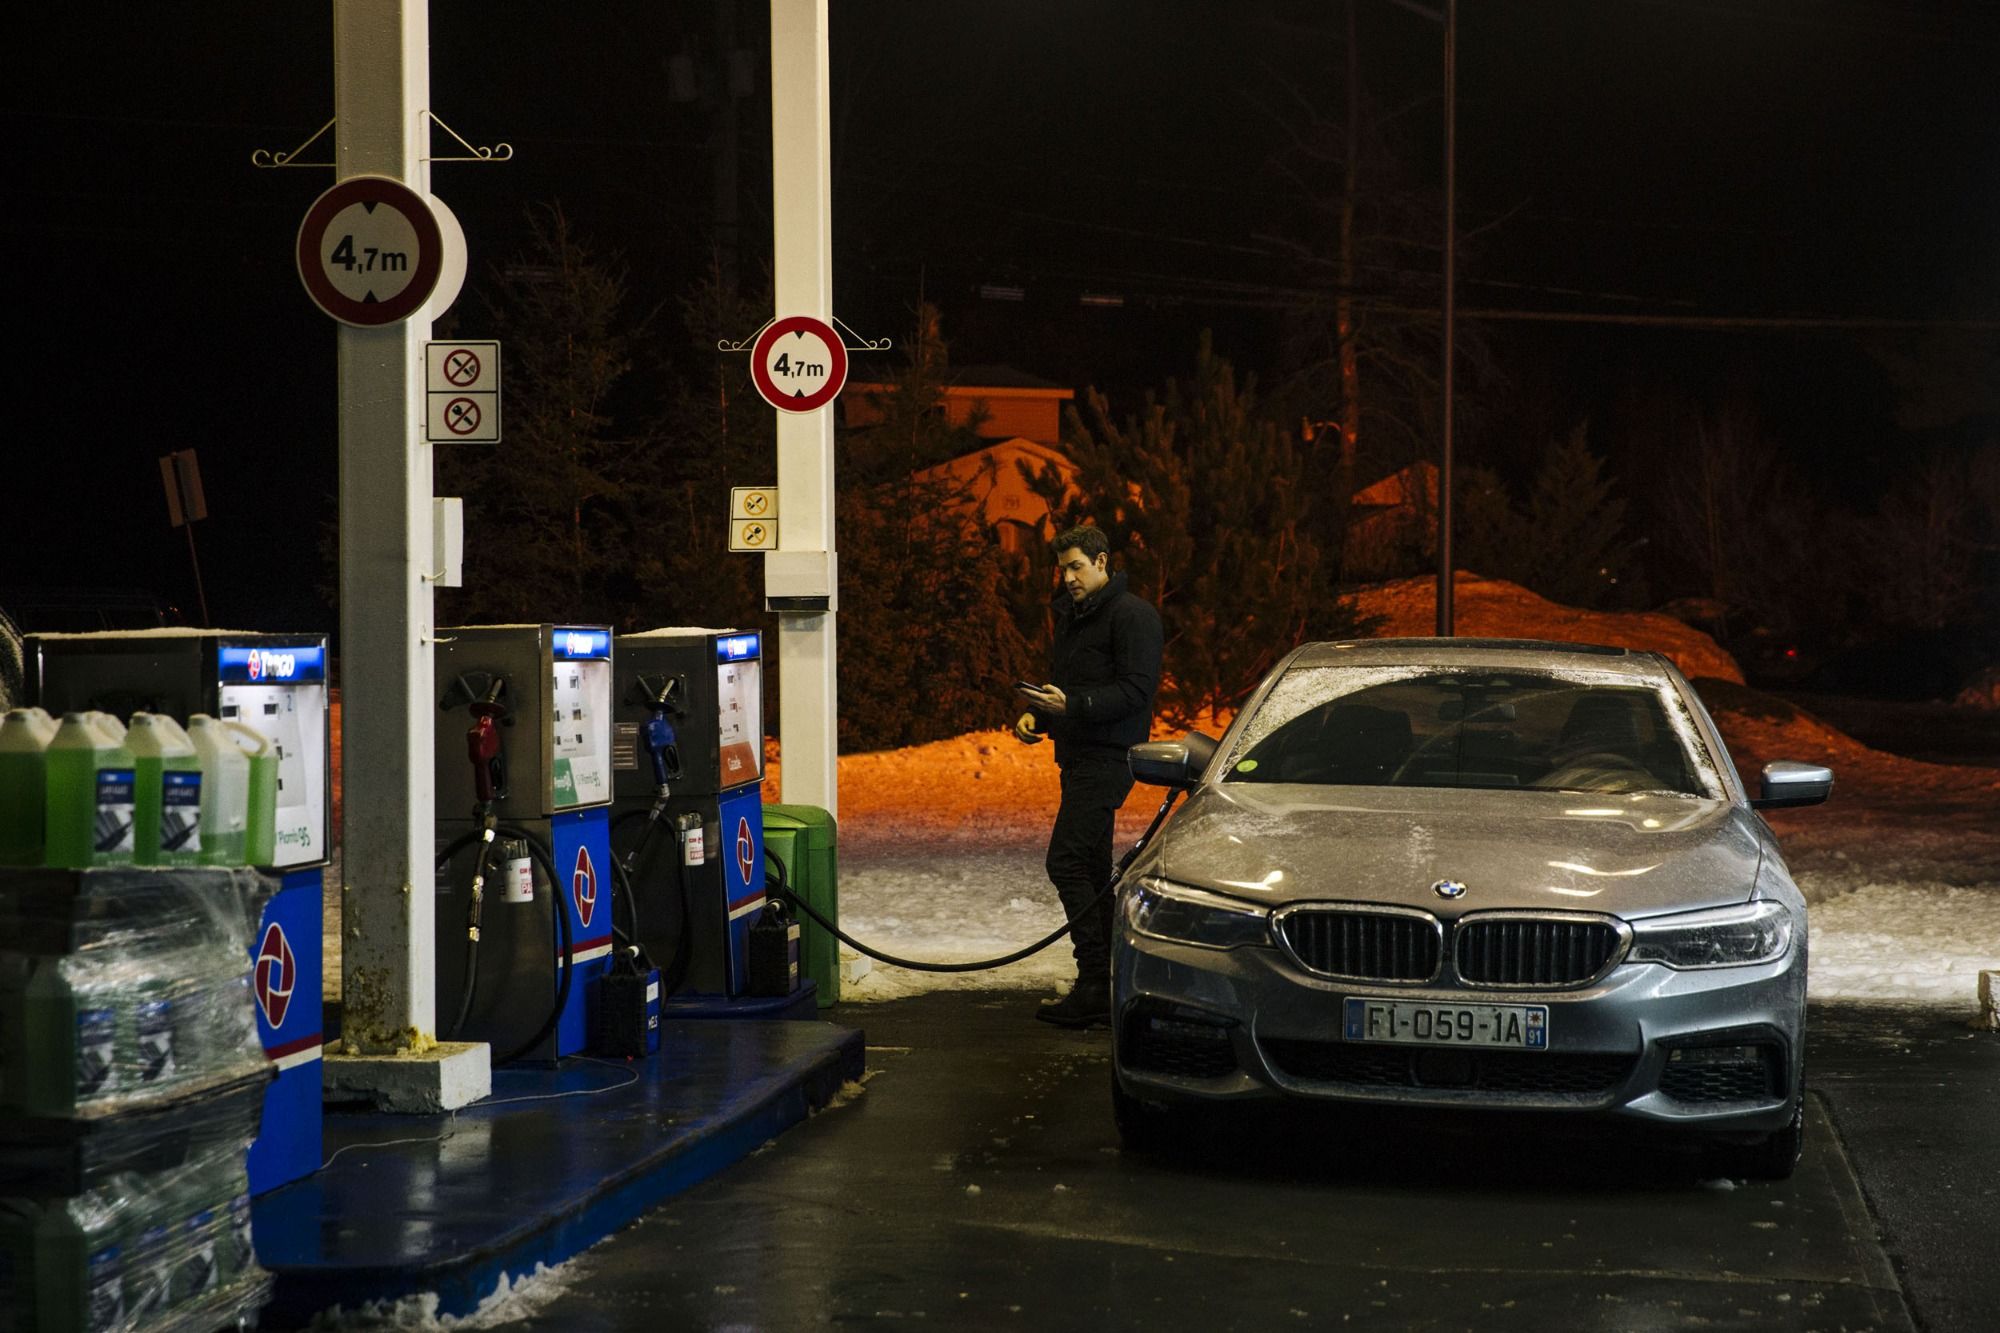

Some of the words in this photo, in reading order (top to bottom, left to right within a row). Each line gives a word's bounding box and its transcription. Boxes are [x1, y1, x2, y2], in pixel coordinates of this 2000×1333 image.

[331, 235, 408, 275] 4,7m
[773, 353, 824, 379] 4,7m
[1528, 1030, 1541, 1044] 91
